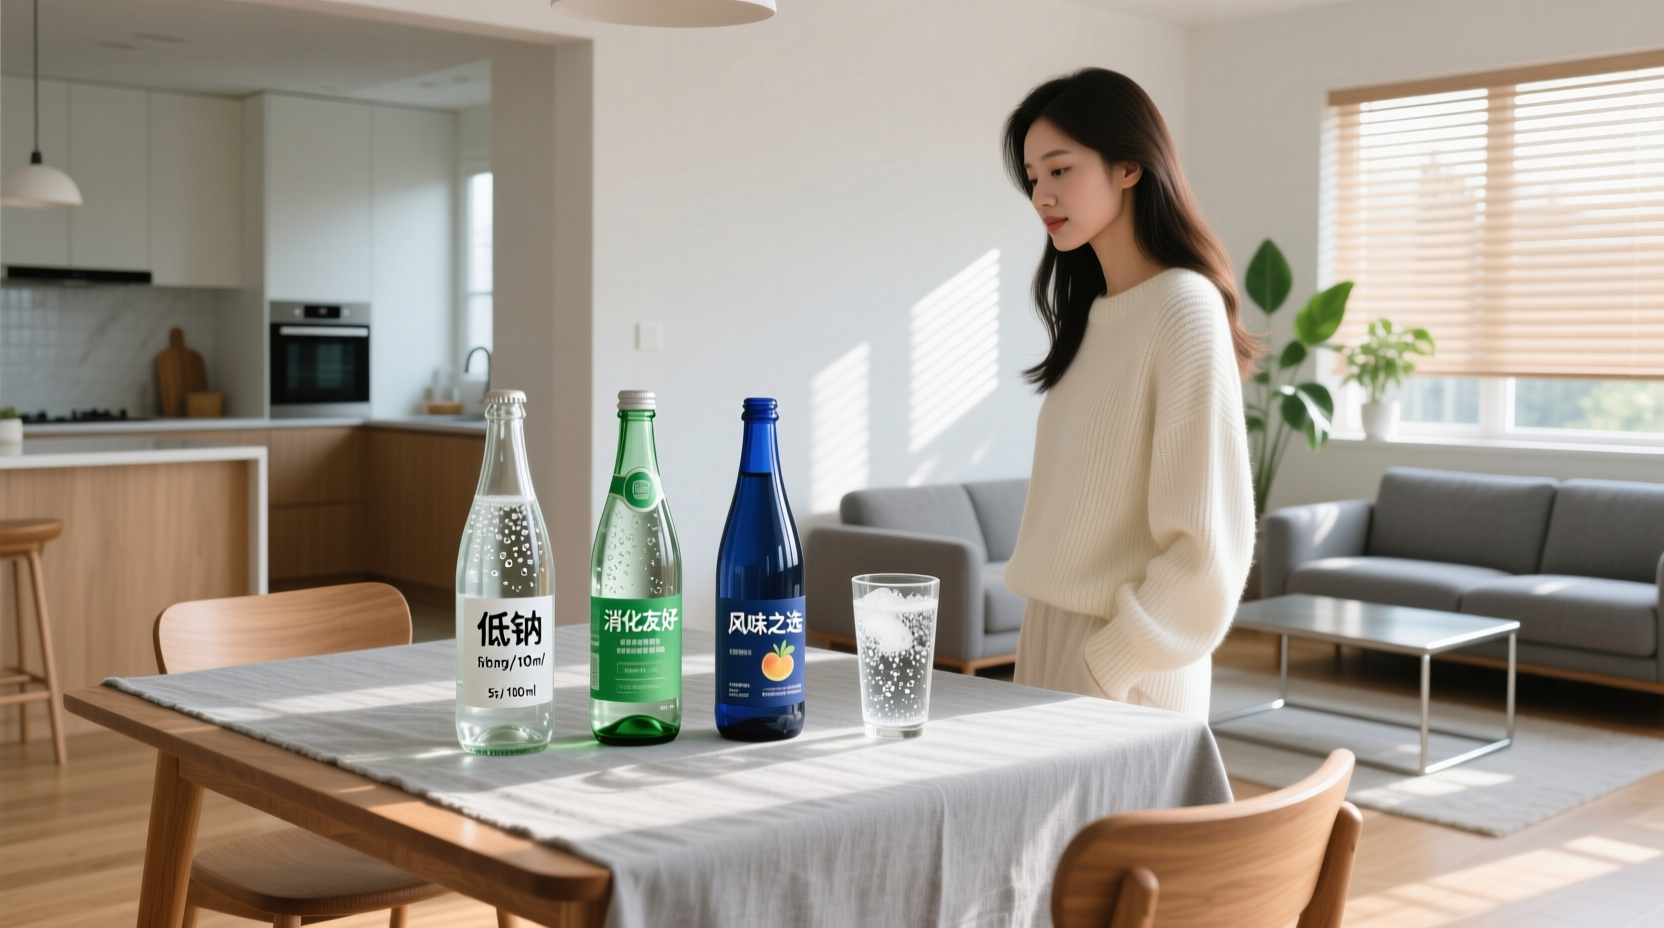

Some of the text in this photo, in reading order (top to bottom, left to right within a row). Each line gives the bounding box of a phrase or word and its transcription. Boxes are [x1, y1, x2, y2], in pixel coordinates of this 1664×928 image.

[477, 610, 542, 647] 低钠
[604, 608, 678, 632] 消化友好
[728, 609, 803, 635] 风味之选
